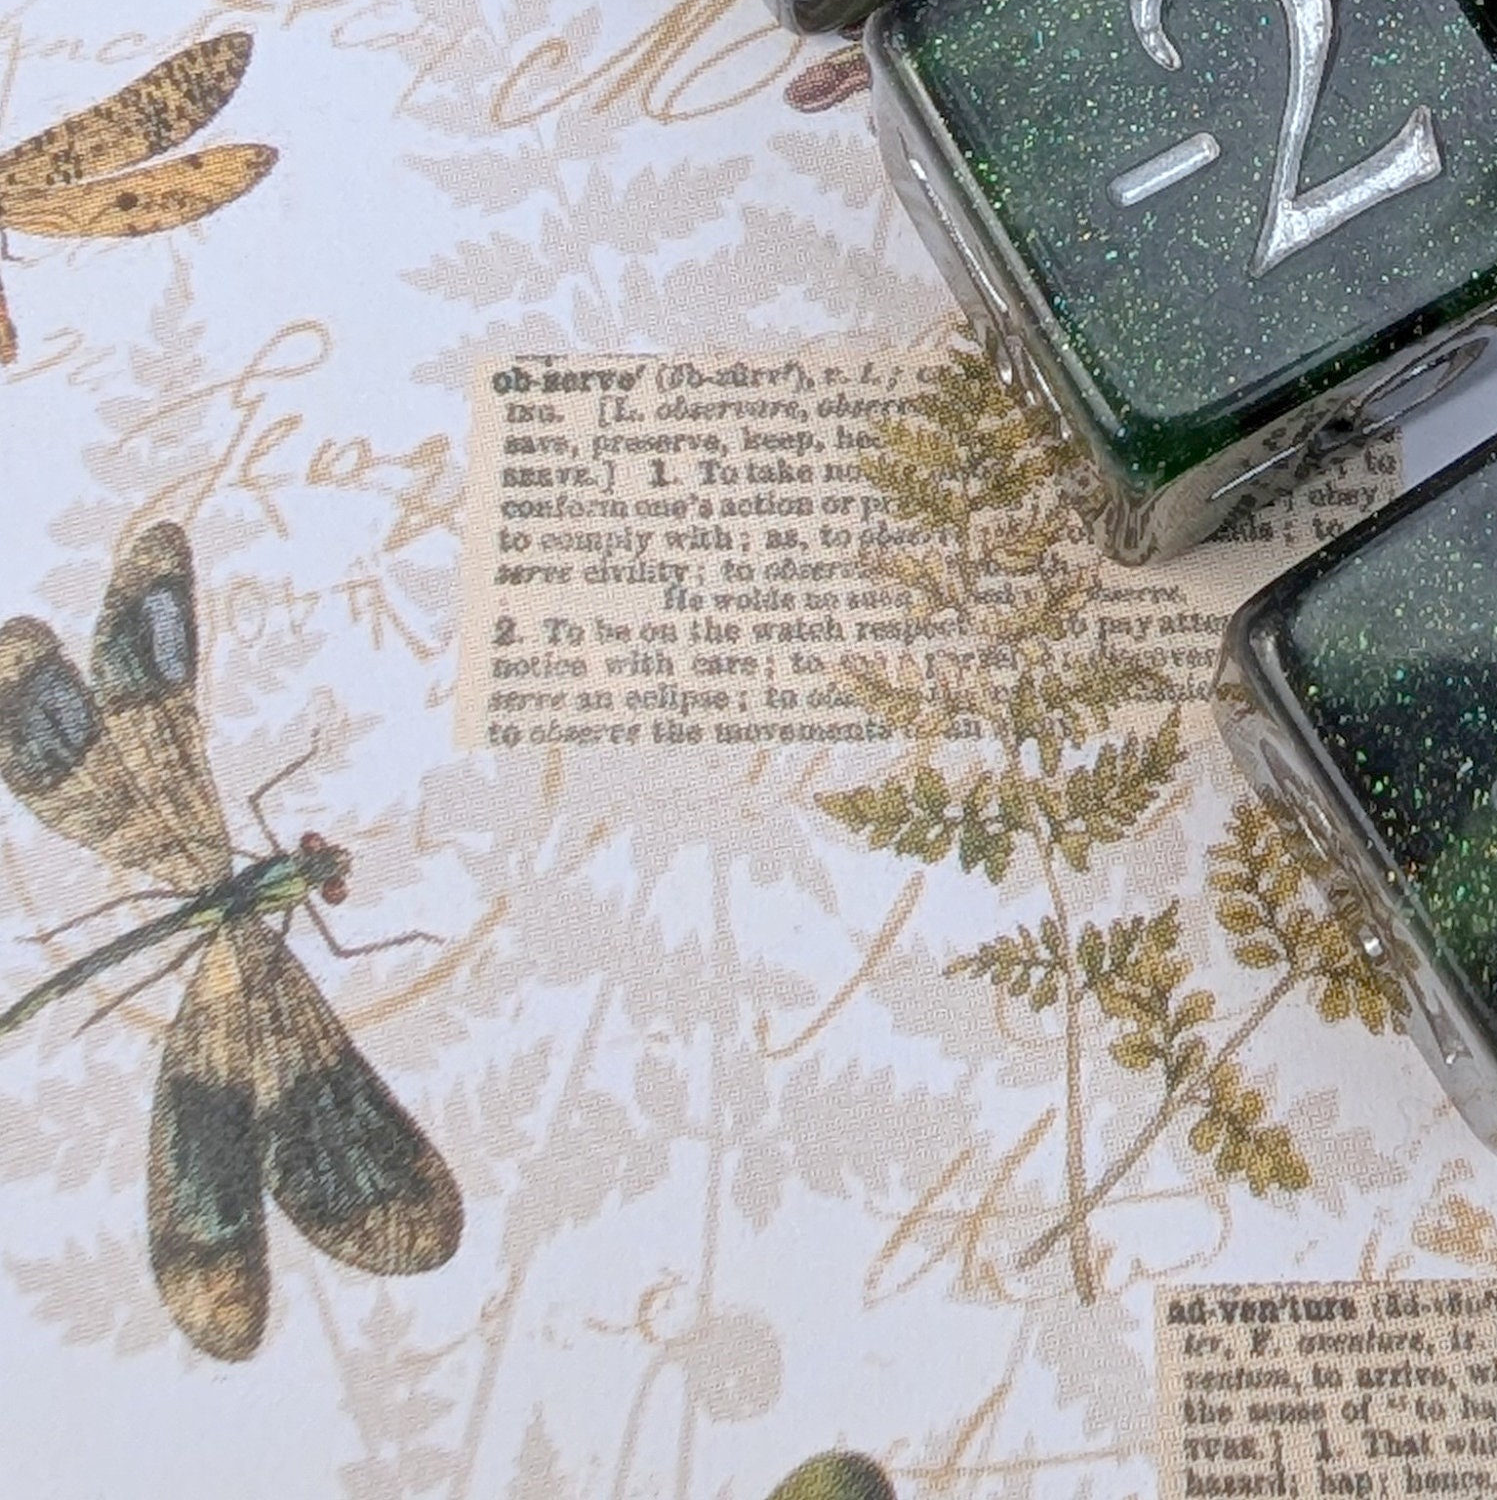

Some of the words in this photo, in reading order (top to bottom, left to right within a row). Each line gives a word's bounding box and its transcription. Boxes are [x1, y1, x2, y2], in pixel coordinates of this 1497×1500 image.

[592, 432, 728, 460] preserve,
[741, 426, 826, 456] keep,
[699, 459, 739, 486] To
[747, 457, 813, 484] take
[541, 526, 654, 557] comply
[687, 615, 740, 644] the
[752, 615, 846, 643] watch
[604, 650, 674, 676] with
[652, 719, 703, 744] the
[1183, 1396, 1233, 1425] the
[1361, 1428, 1431, 1457] That
